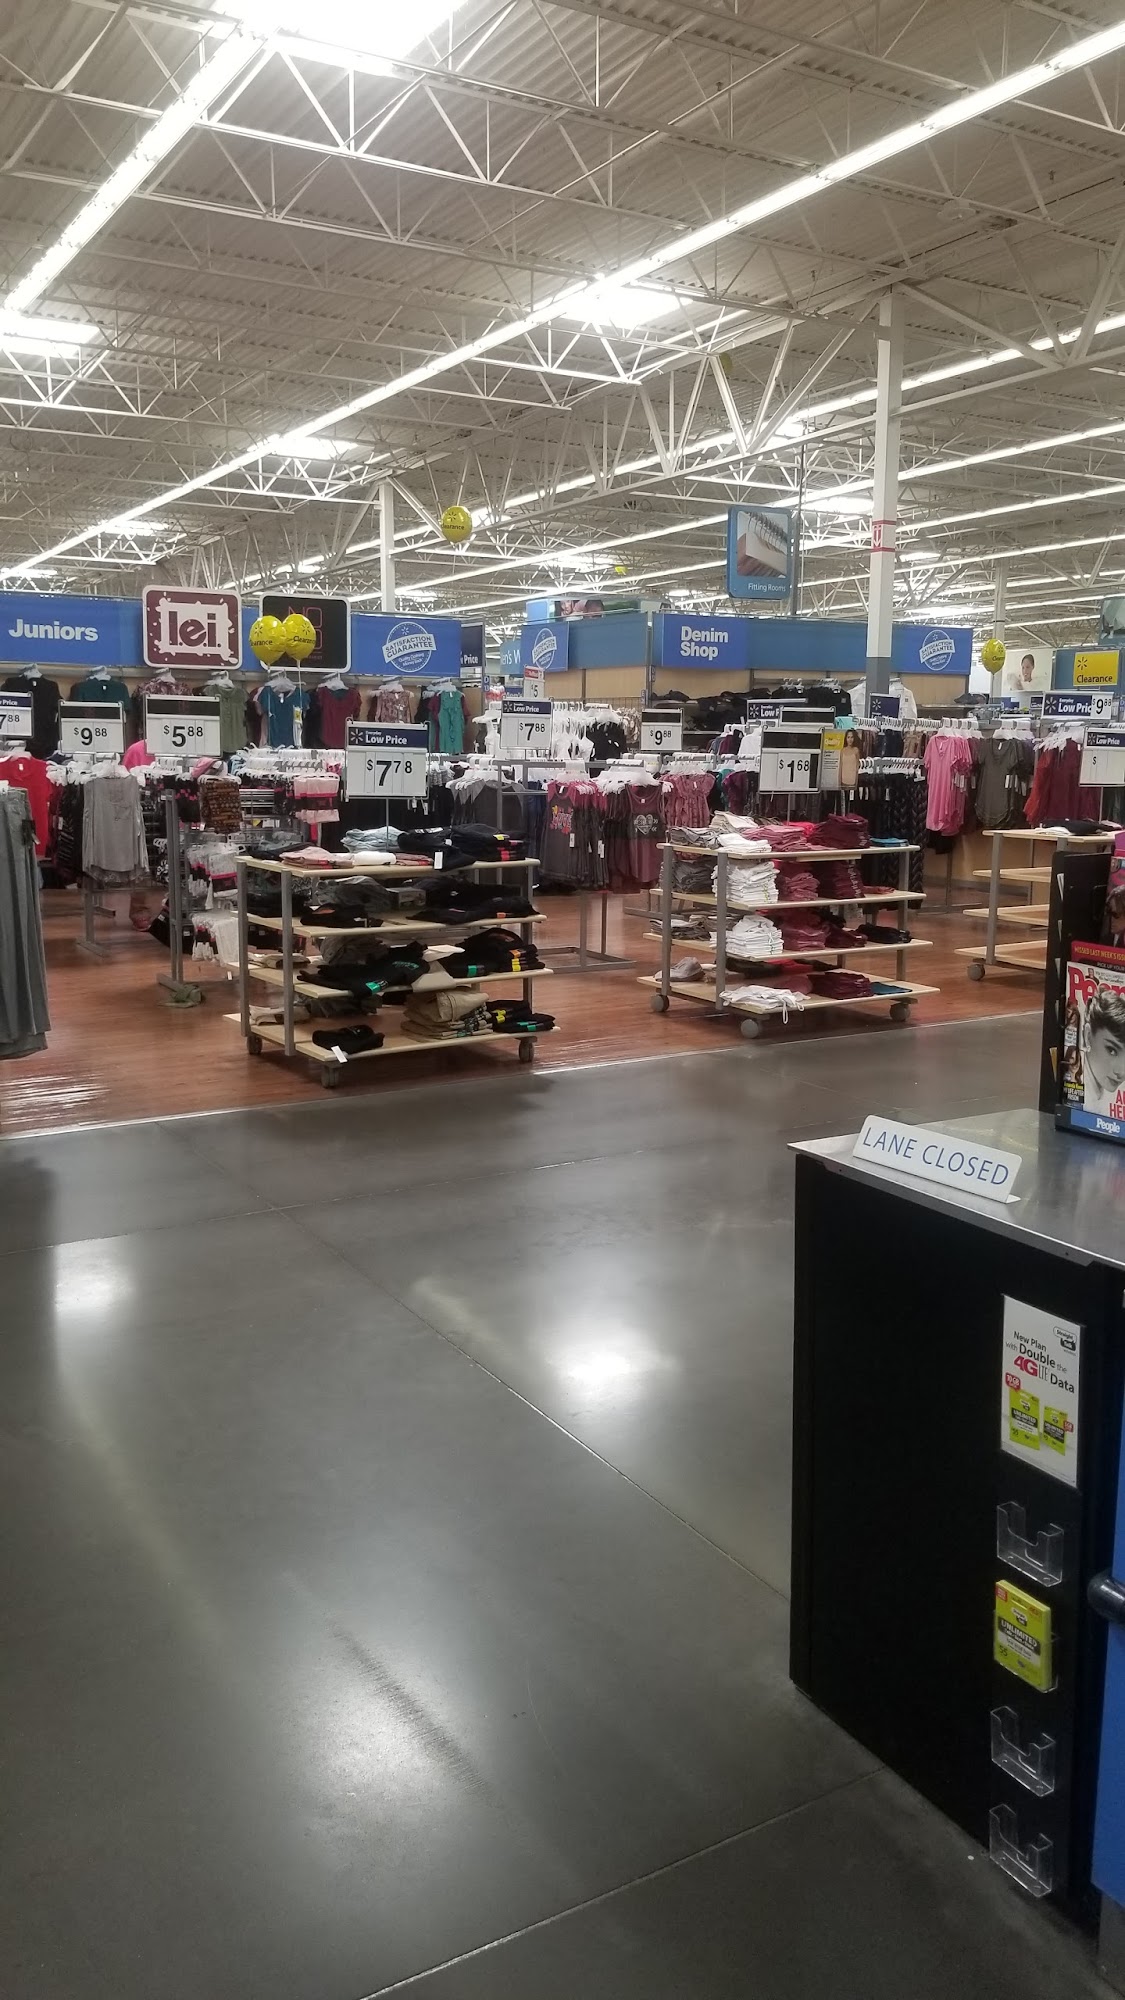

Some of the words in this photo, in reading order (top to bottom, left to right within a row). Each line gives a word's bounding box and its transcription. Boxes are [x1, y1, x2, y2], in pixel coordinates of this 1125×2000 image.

[748, 582, 767, 592] Fitting
[768, 584, 786, 592] Rooms
[8, 618, 99, 642] Juniors
[681, 626, 729, 643] Denim
[386, 636, 432, 652] SATISFACTION
[387, 642, 433, 658] GUARANTEE
[680, 642, 719, 660] Shop
[464, 654, 478, 664] Price
[1077, 675, 1113, 683] Clearance
[1058, 703, 1075, 713] Low
[1076, 703, 1091, 713] Pric
[365, 735, 384, 743] Low
[386, 735, 407, 744] Price
[1107, 738, 1120, 746] Price
[1090, 949, 1100, 957] LAST
[1096, 1117, 1120, 1134] People
[863, 1127, 917, 1158] LANE
[922, 1145, 1009, 1185] CLOSED
[1014, 1331, 1030, 1344] New
[1031, 1338, 1047, 1352] Plan
[1006, 1341, 1018, 1352] with
[1020, 1343, 1056, 1369] Double
[1057, 1363, 1067, 1373] the
[1014, 1355, 1038, 1377] 4G
[1050, 1373, 1075, 1393] Data
[1001, 1620, 1038, 1647] UNLIMITED
